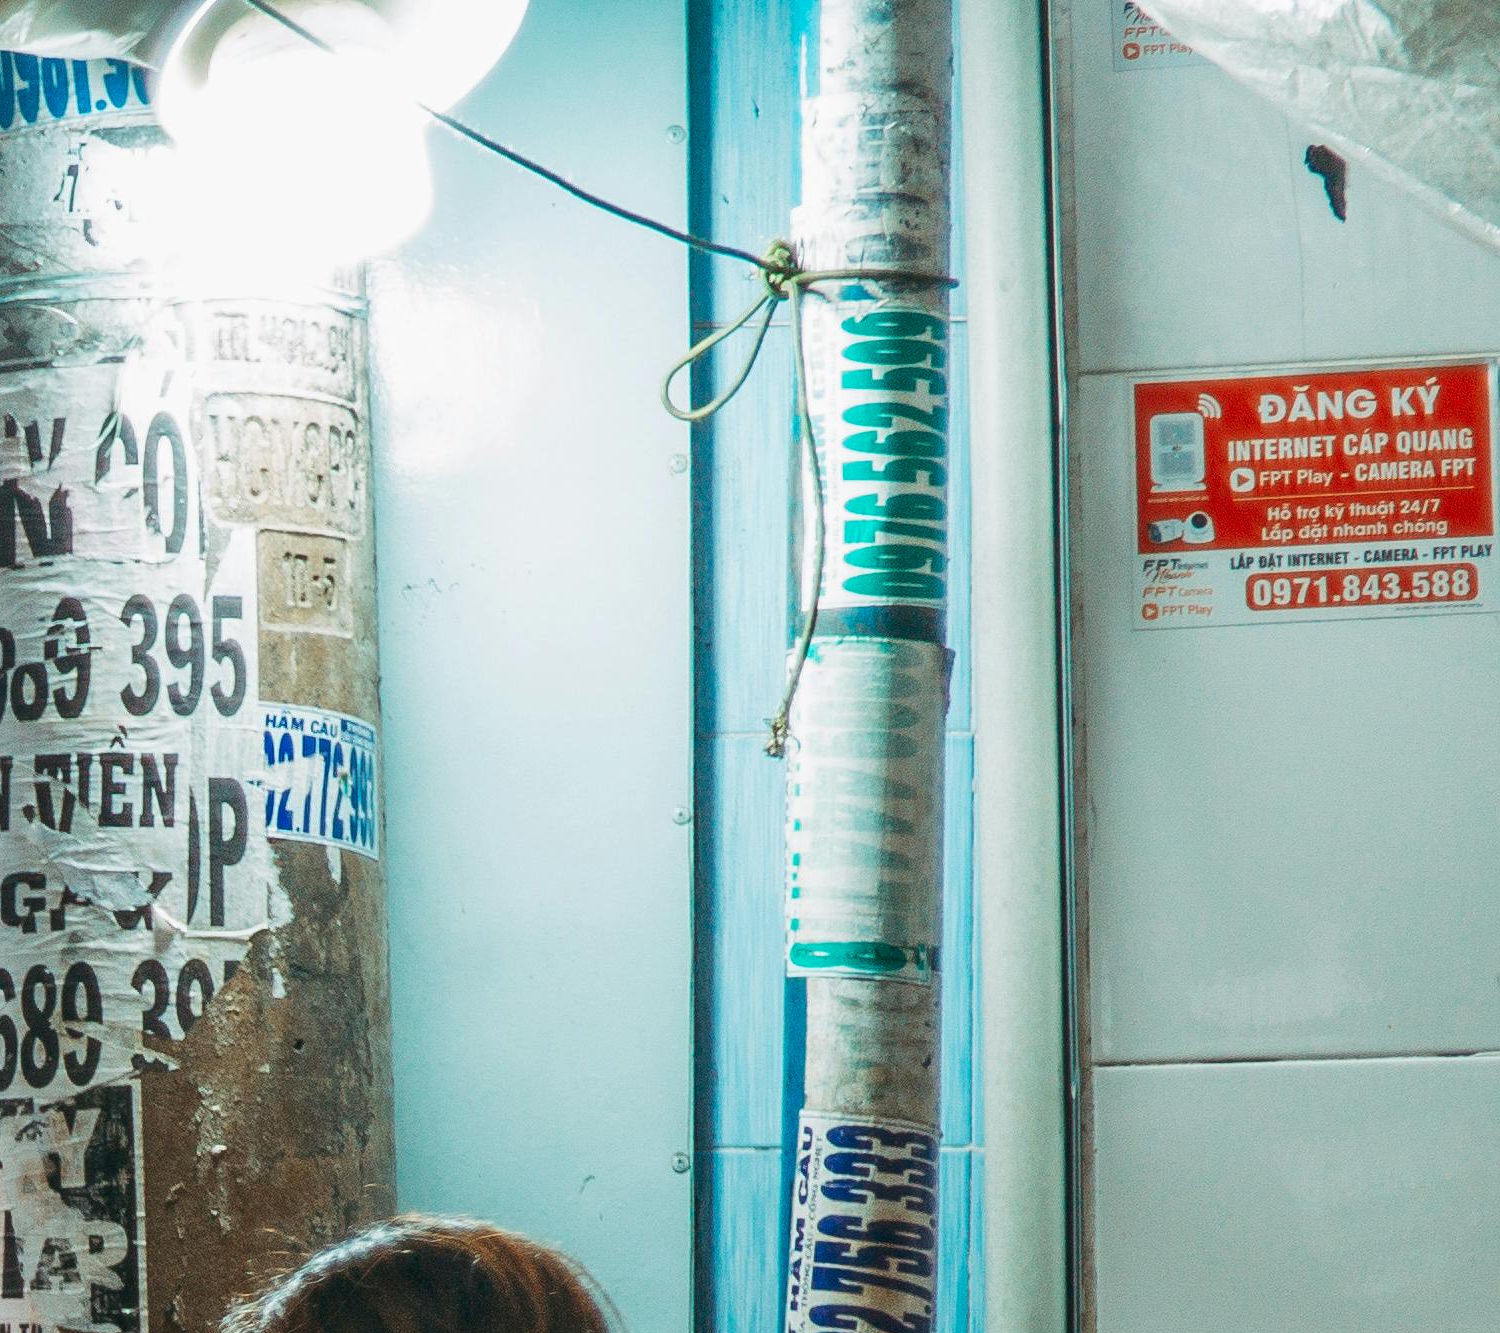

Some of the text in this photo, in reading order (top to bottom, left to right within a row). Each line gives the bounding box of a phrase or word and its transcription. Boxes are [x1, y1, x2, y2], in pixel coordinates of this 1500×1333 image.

[840, 310, 948, 396] 599
[1258, 377, 1440, 424] ĐĂNG KÝ
[841, 401, 948, 487] 562
[1228, 428, 1473, 462] INTERNET CÁP QUANG
[1259, 469, 1293, 486] FPT
[1297, 469, 1334, 487] Play
[1355, 460, 1435, 482] CAMERA
[1441, 458, 1477, 477] FPT
[1267, 499, 1441, 522] Hỗ trợ kỹ thuật 24/7
[842, 493, 948, 600] 0976
[1298, 522, 1328, 542] đặt
[1333, 518, 1387, 537] nhanh
[1393, 518, 1448, 536] chóng
[1287, 551, 1349, 567] INTERNET
[1363, 547, 1419, 564] CAMERA
[1433, 545, 1457, 560] FPT
[1461, 543, 1493, 559] PLAY
[1142, 586, 1177, 598] FPT
[1252, 568, 1471, 607] 0971.843.588
[1162, 604, 1213, 616] FPT Play
[120, 594, 246, 718] 395
